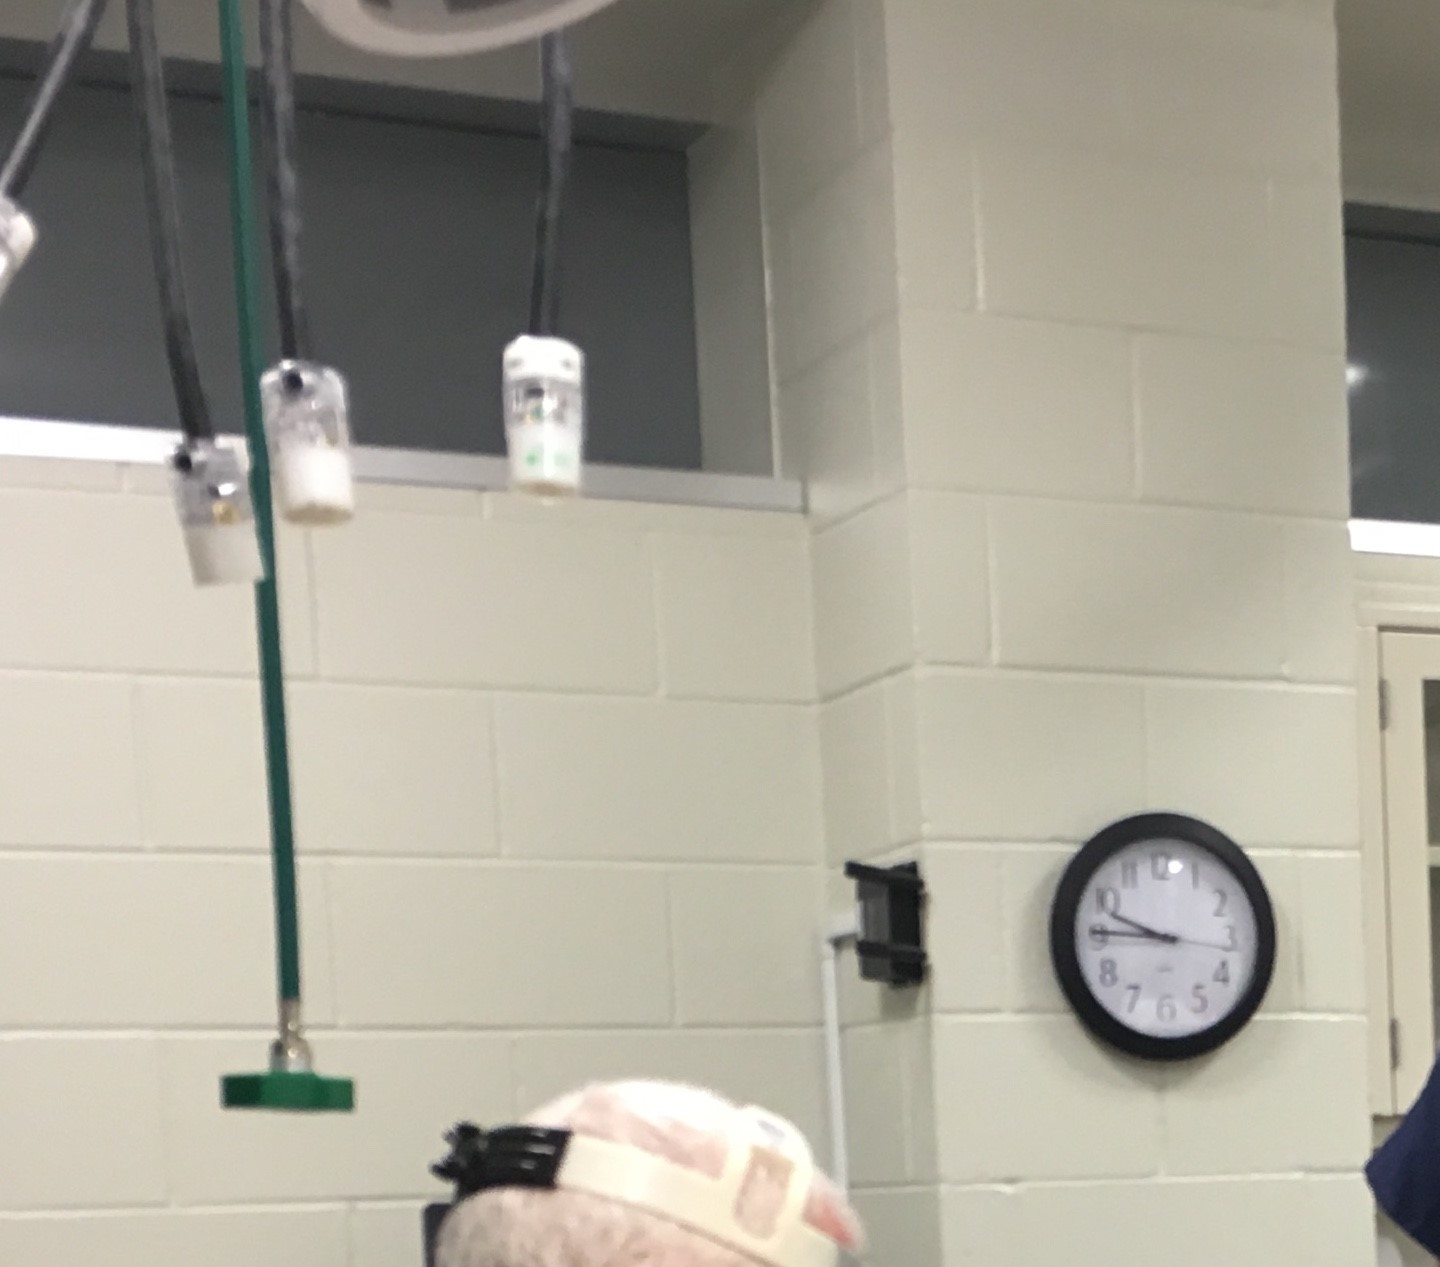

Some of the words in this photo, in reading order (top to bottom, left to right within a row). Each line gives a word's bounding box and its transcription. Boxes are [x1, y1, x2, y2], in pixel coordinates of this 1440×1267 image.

[1122, 861, 1138, 889] 11
[1191, 861, 1199, 890] 1
[1096, 887, 1120, 915] 10
[1213, 888, 1228, 917] 2
[1224, 924, 1239, 952] 3
[1099, 958, 1118, 987] 8
[1212, 959, 1230, 987] 4
[1126, 983, 1142, 1013] 7
[1155, 993, 1178, 1023] 6
[1190, 983, 1209, 1014] 5
